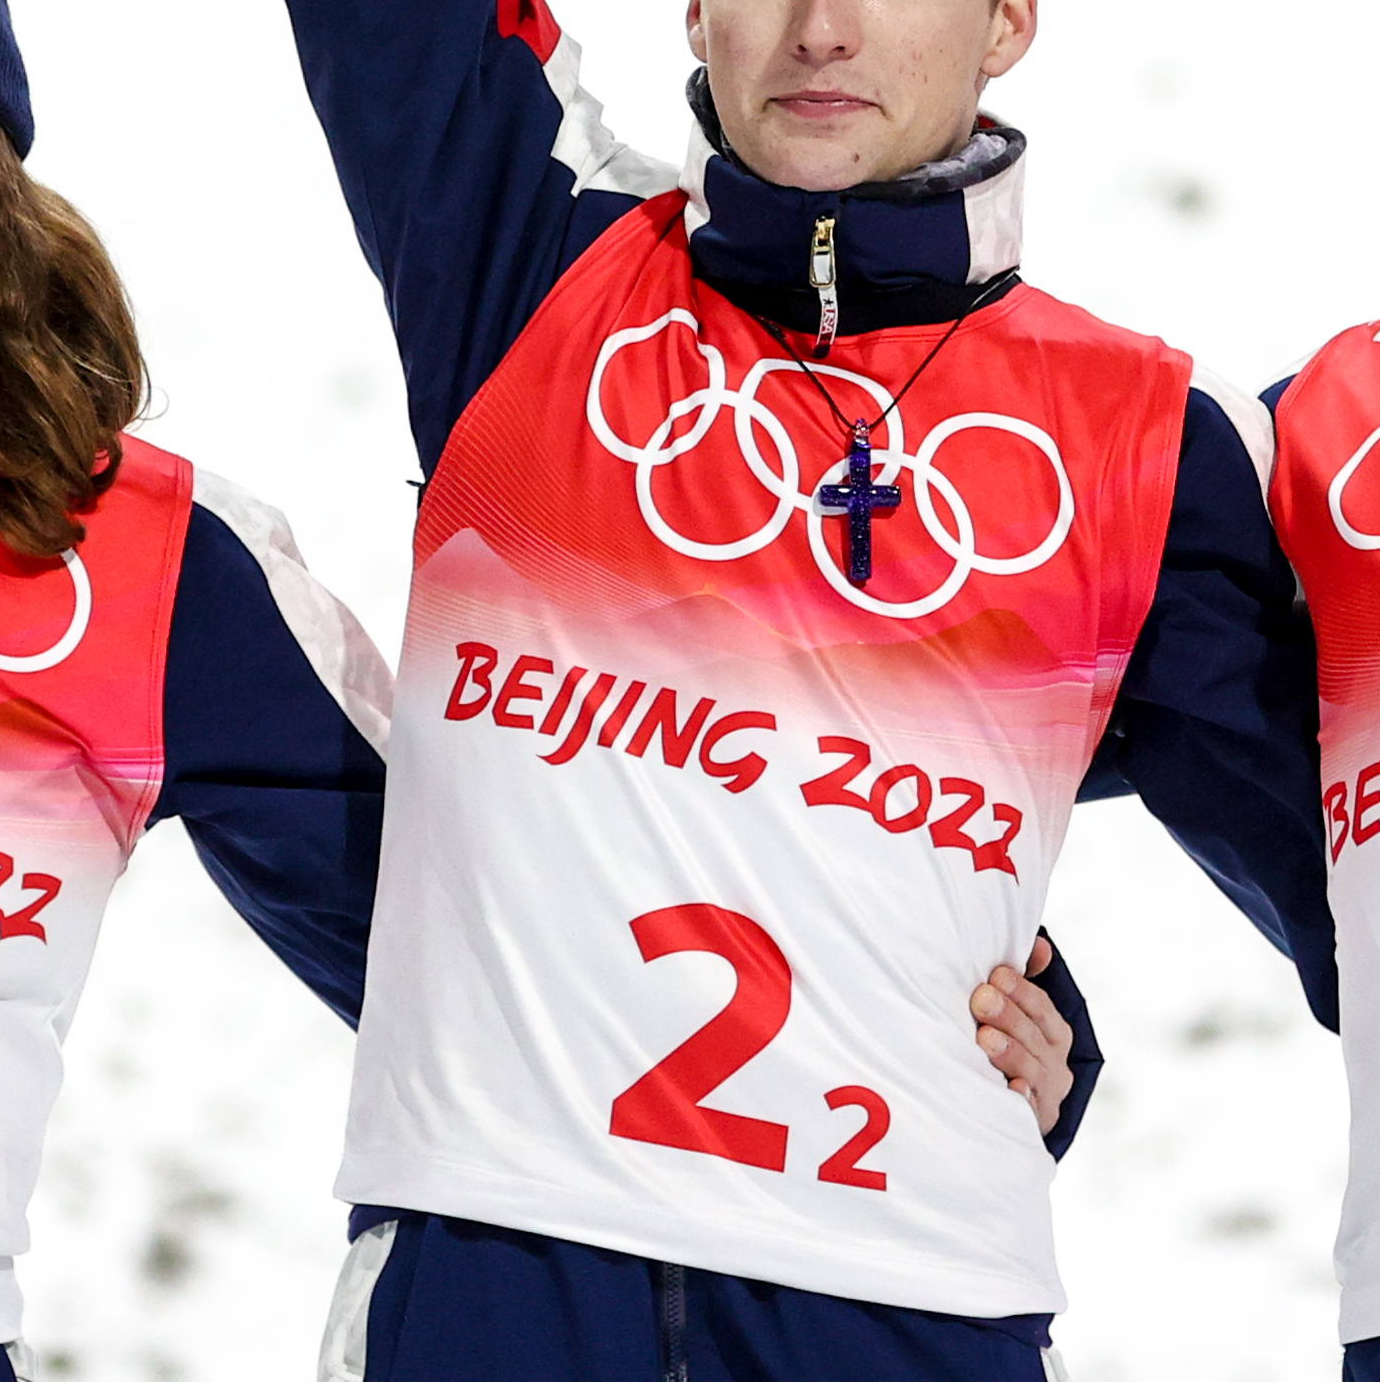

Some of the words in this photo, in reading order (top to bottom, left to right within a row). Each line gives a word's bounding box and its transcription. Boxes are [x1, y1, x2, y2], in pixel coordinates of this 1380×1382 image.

[443, 641, 777, 794] BEIJING
[799, 736, 1023, 886] 2022
[609, 902, 792, 1173] 2
[818, 1084, 891, 1192] 2
